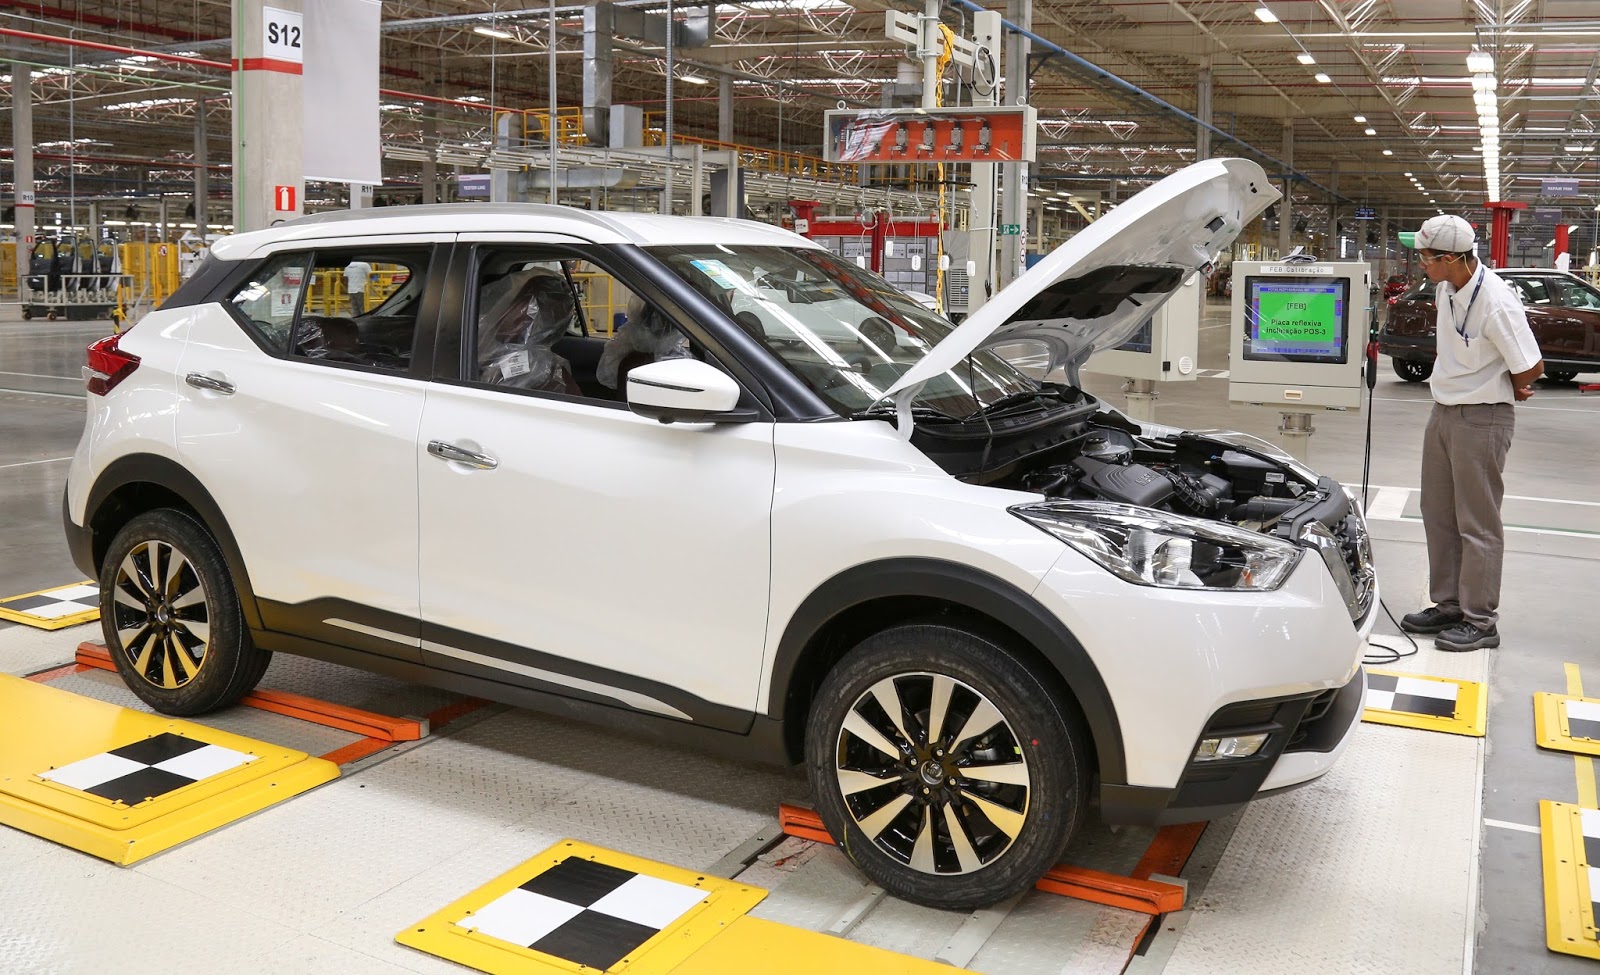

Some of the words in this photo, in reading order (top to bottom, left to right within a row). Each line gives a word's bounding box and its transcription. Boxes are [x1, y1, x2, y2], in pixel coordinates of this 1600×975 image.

[268, 22, 300, 48] S12
[361, 185, 371, 193] R11
[1286, 266, 1324, 274] Calibração
[1286, 302, 1307, 310] [FEB]
[1271, 318, 1289, 326] Placa
[1291, 319, 1322, 327] reflexiva
